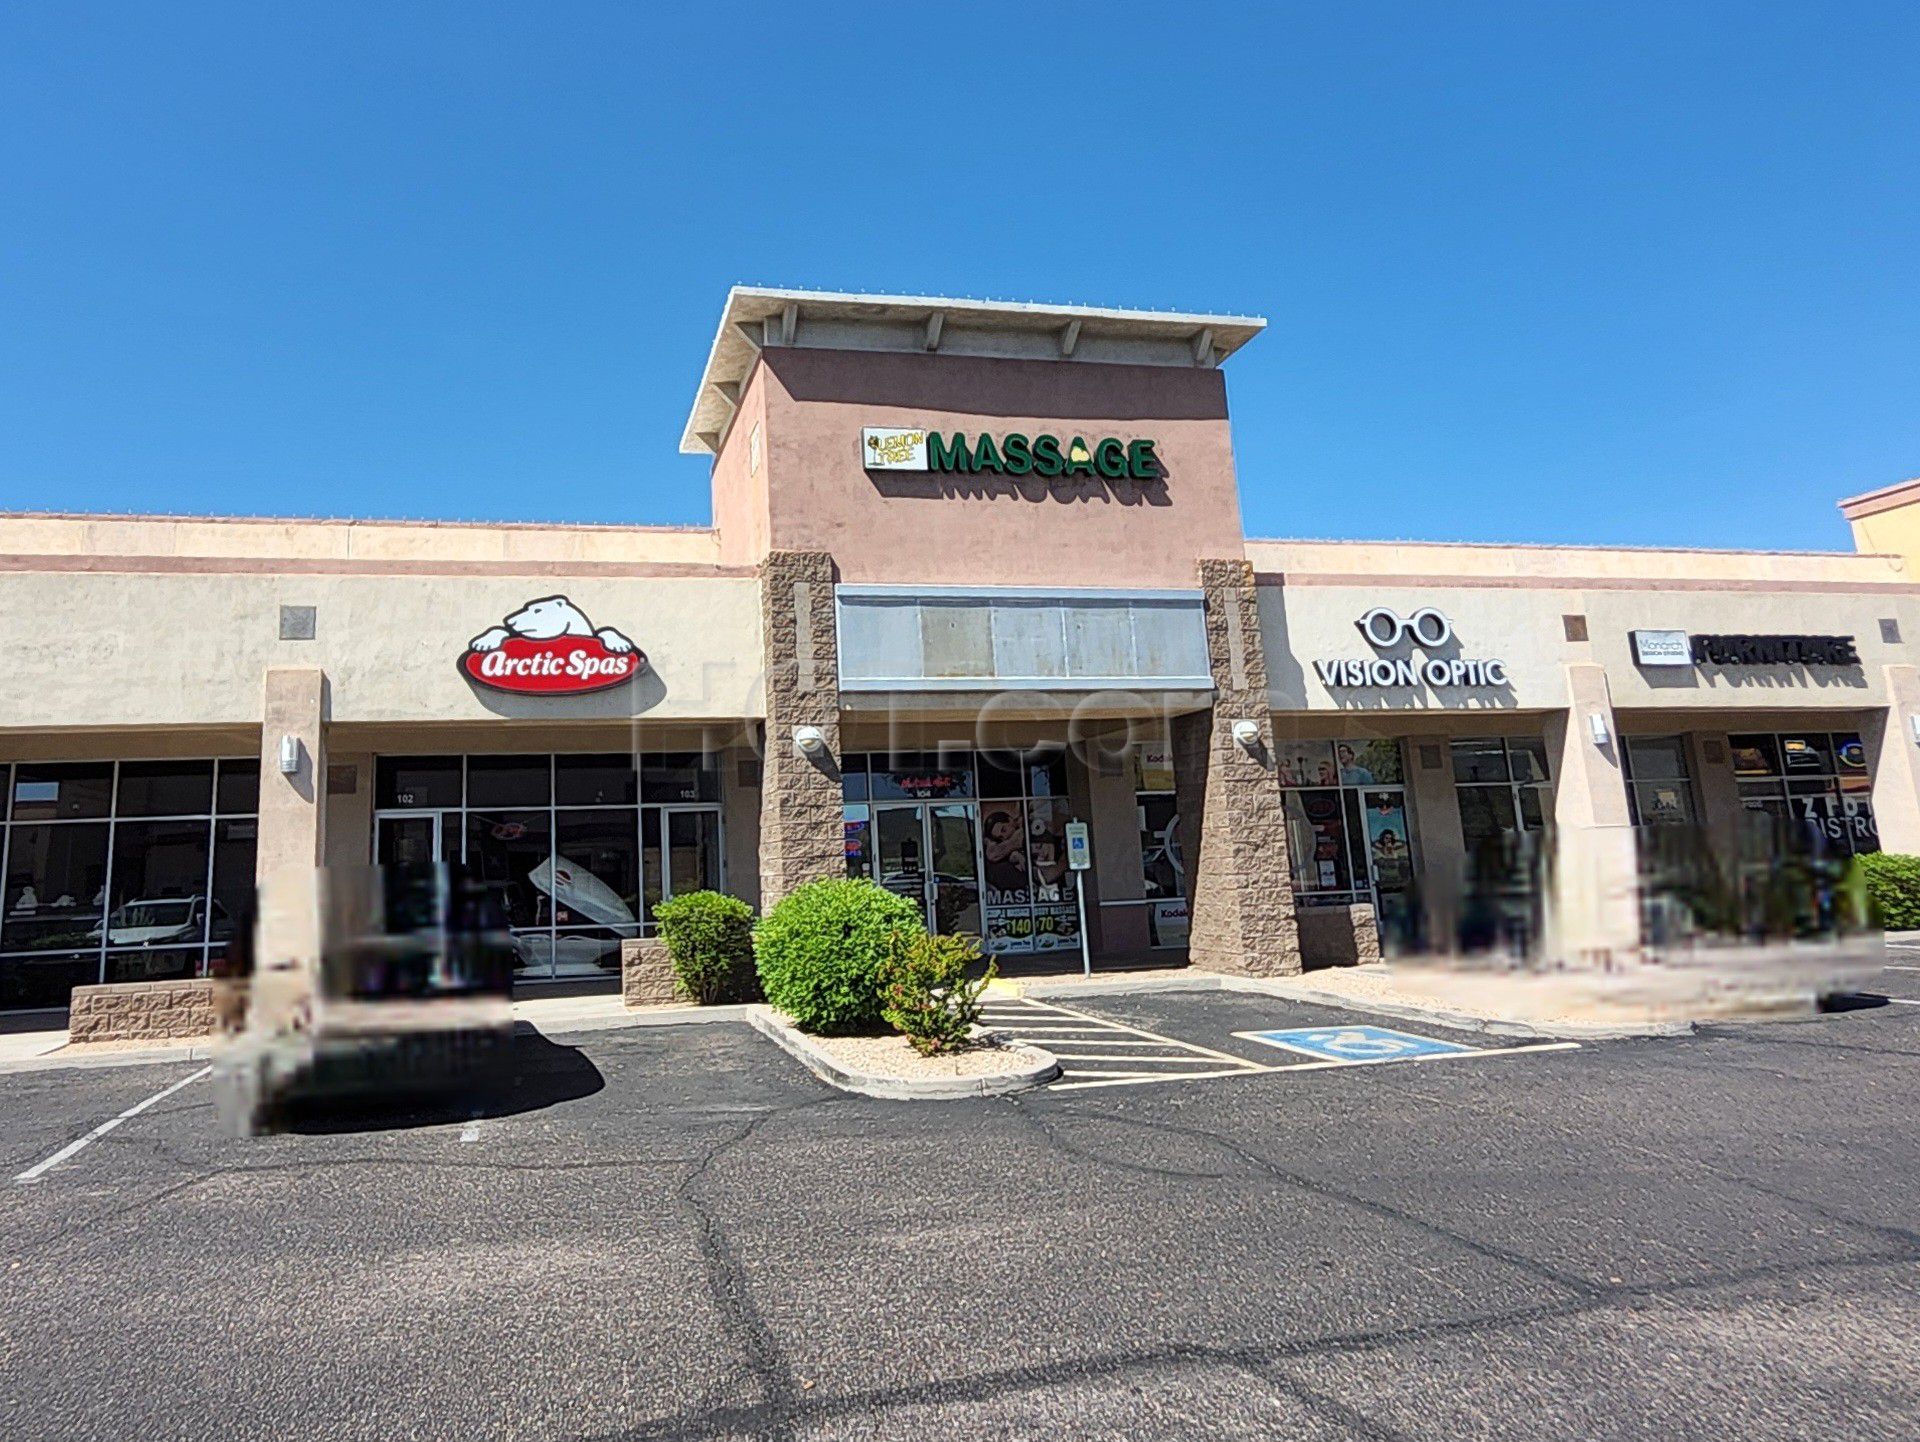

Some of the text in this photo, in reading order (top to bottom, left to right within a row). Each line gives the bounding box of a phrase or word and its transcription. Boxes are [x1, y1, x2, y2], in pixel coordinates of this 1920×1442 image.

[928, 431, 1160, 478] MASSAGE
[481, 649, 628, 680] Arctic Spas
[1319, 658, 1507, 687] VISION OPTIC
[397, 794, 414, 804] 102
